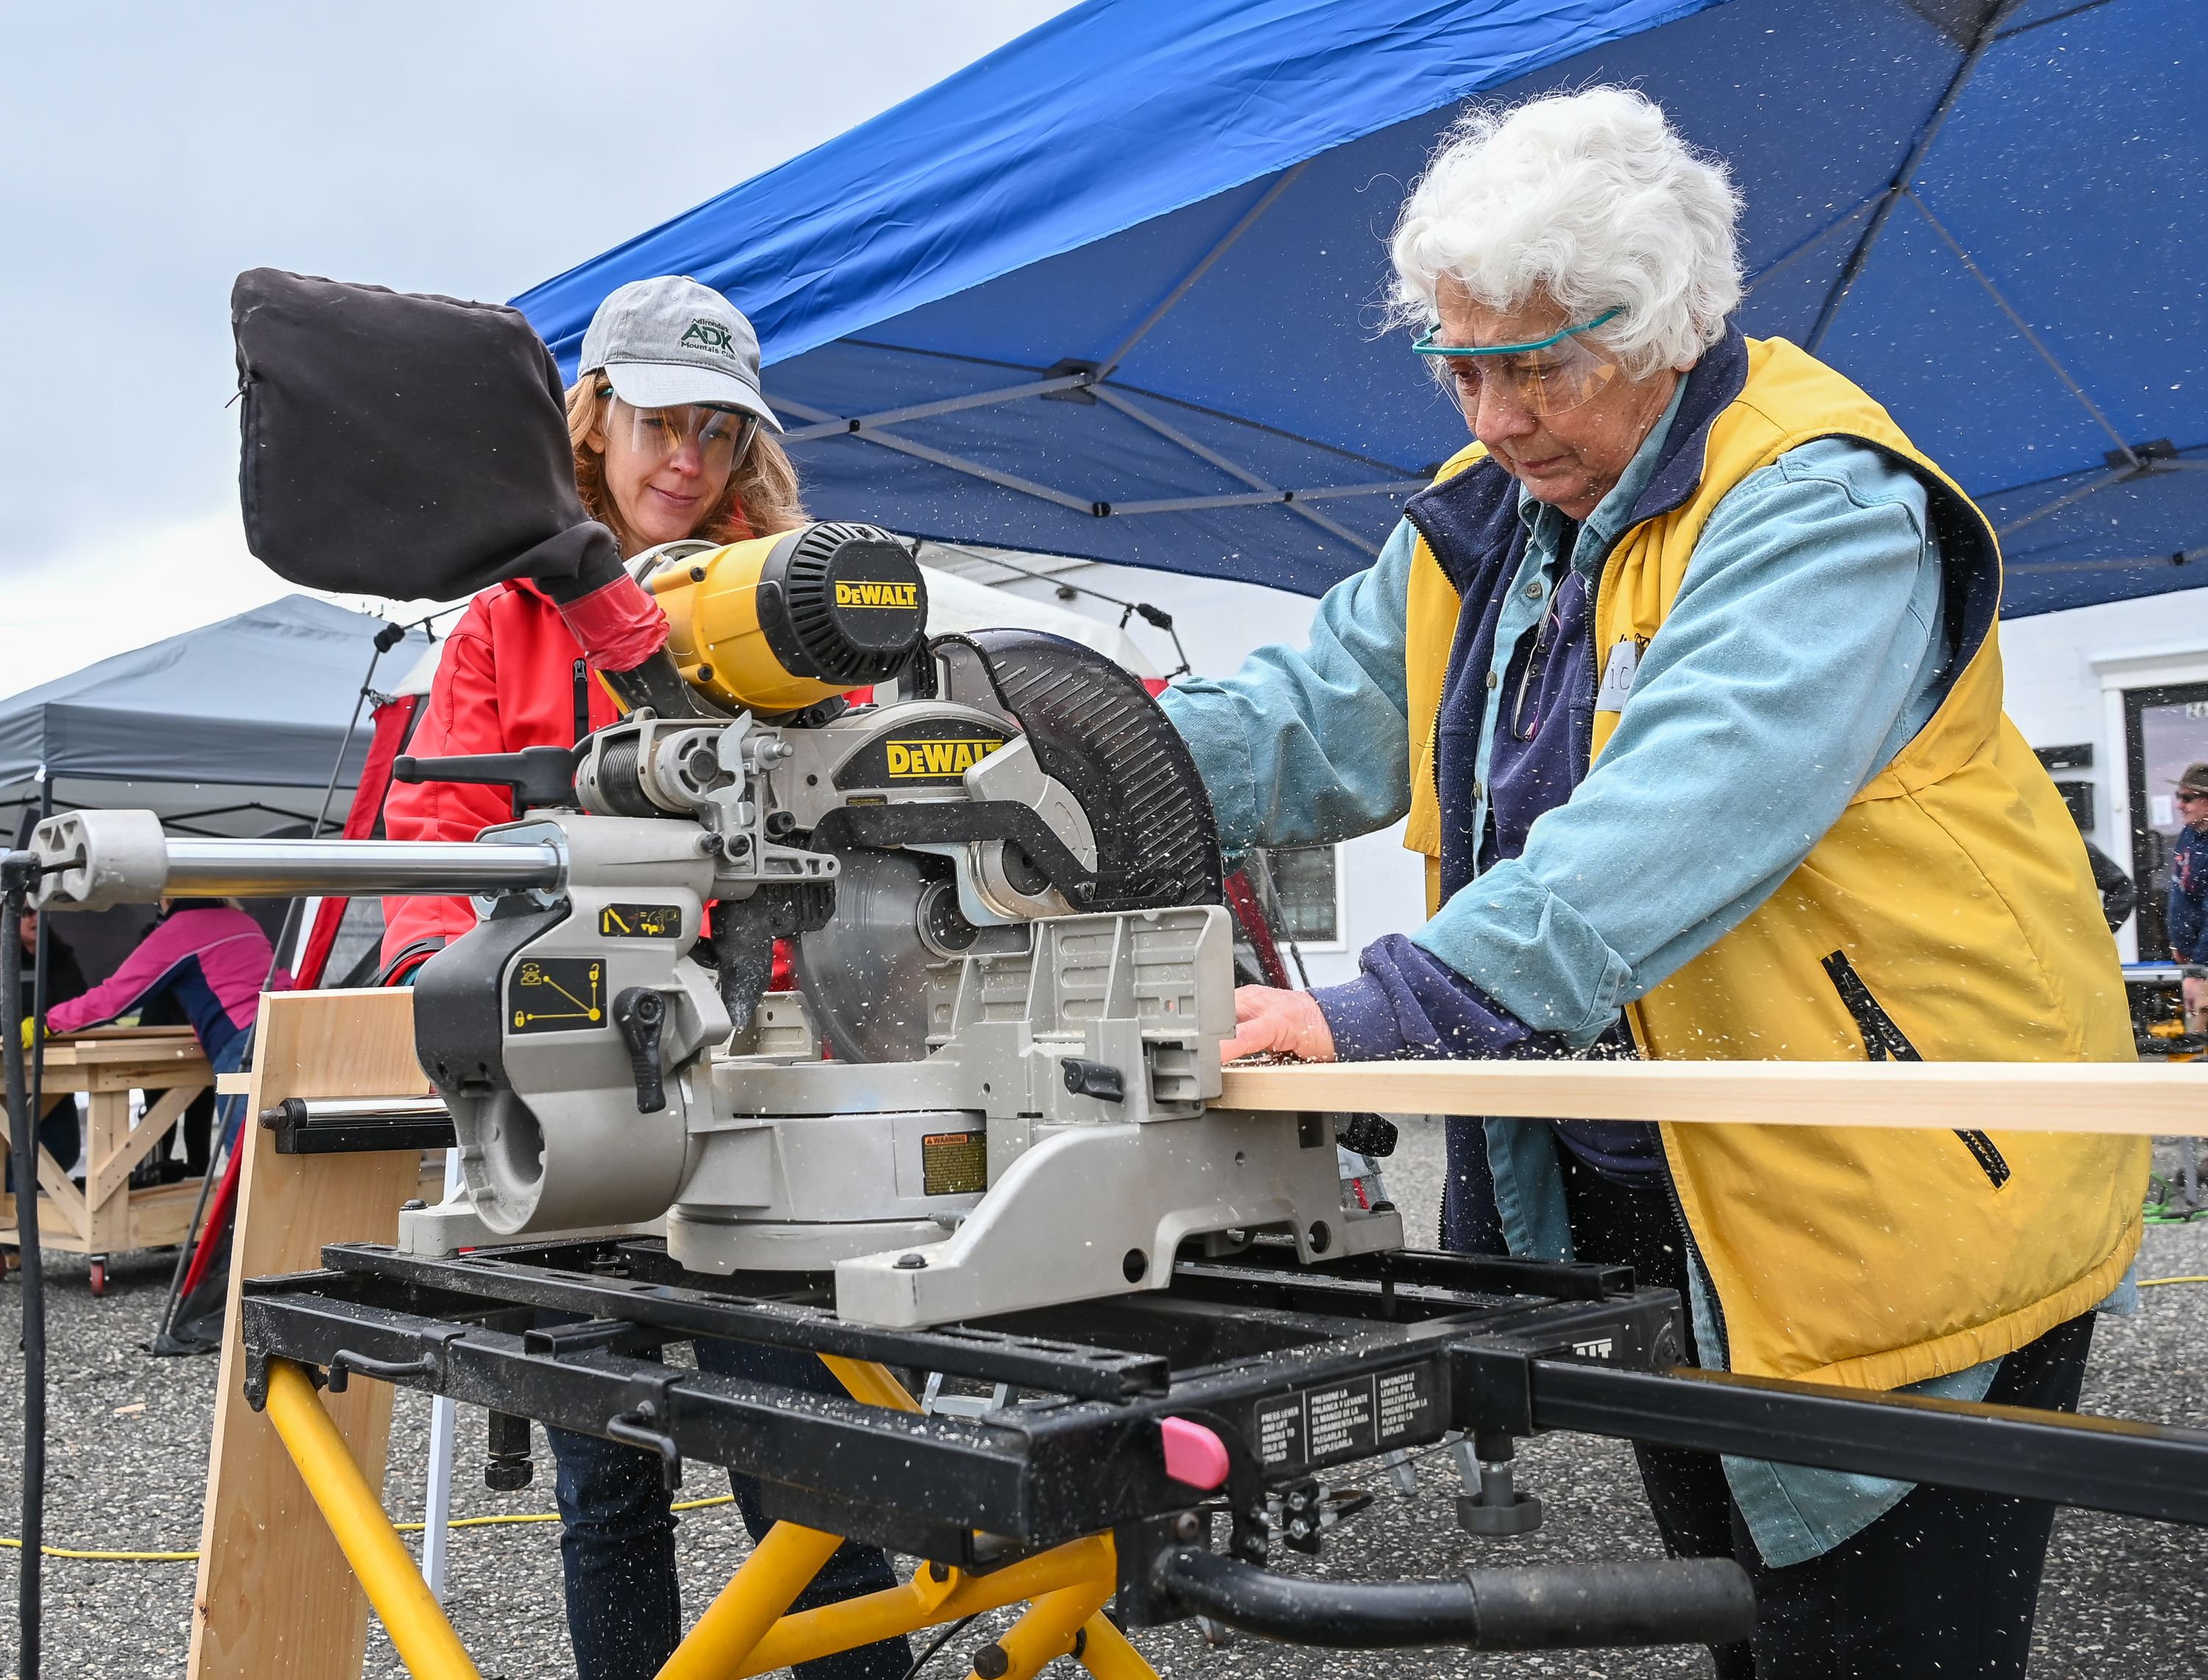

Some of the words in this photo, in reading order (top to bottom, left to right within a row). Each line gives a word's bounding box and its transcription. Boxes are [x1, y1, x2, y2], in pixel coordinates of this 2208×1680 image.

[681, 323, 735, 354] ADK
[681, 341, 719, 354] Mountain
[721, 350, 736, 361] Club
[835, 584, 917, 606] DEWALT
[933, 1135, 966, 1144] WARNING
[1380, 1373, 1408, 1388] ENFONCER
[1409, 1372, 1415, 1381] LE
[1400, 1382, 1414, 1392] PUIS
[1312, 1390, 1339, 1405] PRESIONE
[1340, 1389, 1348, 1399] LA
[1312, 1401, 1339, 1415] PALANCA
[1339, 1400, 1343, 1408] Y
[1344, 1393, 1368, 1408] LEVANTE
[1381, 1393, 1408, 1407] SOULEVER
[1409, 1391, 1416, 1400] LA
[1405, 1400, 1420, 1410] POUR
[1420, 1397, 1428, 1407] LA
[1261, 1411, 1281, 1423] PRESS
[1281, 1406, 1299, 1419] LEVER
[1312, 1416, 1319, 1425] EL
[1320, 1409, 1342, 1423] MANGO
[1342, 1408, 1350, 1417] DE
[1351, 1406, 1359, 1416] LA
[1381, 1415, 1397, 1427] PLIER
[1397, 1413, 1406, 1422] OU
[1406, 1411, 1414, 1421] LA
[1262, 1422, 1275, 1433] AND
[1275, 1419, 1288, 1431] LIFT
[1312, 1418, 1353, 1436] HERRAMIENTA
[1354, 1413, 1370, 1425] PARA
[1262, 1429, 1286, 1444] HANDLE
[1287, 1428, 1295, 1438] TO
[1313, 1431, 1342, 1445] PLEGARLA
[1342, 1428, 1348, 1438] O
[1278, 1439, 1287, 1450] OR
[1313, 1437, 1354, 1456] DESPLEGARLA
